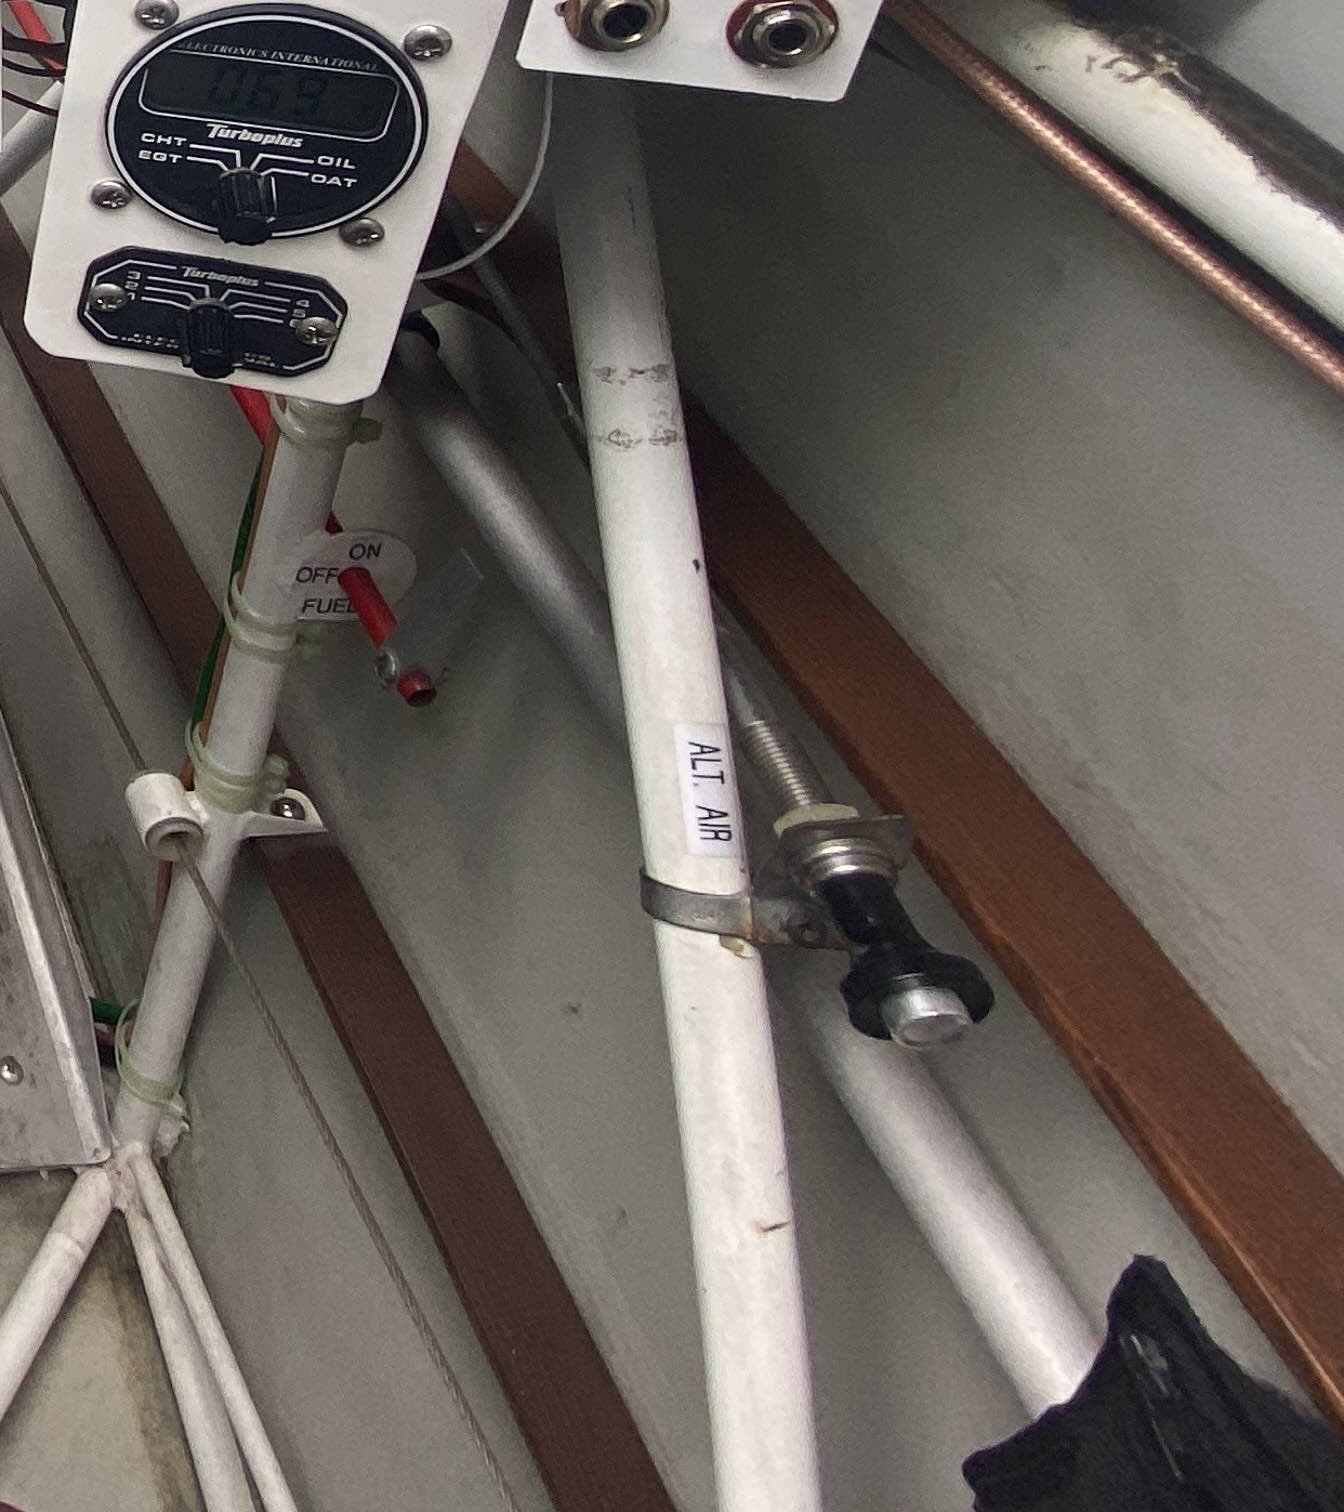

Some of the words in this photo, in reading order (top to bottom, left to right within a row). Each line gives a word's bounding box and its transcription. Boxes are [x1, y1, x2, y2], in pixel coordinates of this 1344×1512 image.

[141, 133, 187, 147] CHT
[206, 123, 302, 148] Turboplus
[138, 150, 182, 164] EGT
[317, 155, 356, 169] OIL
[311, 174, 357, 189] OAT
[181, 265, 259, 287] Turboplus
[349, 543, 381, 560] ON
[296, 567, 339, 583] OFF
[696, 805, 732, 841] AIR
